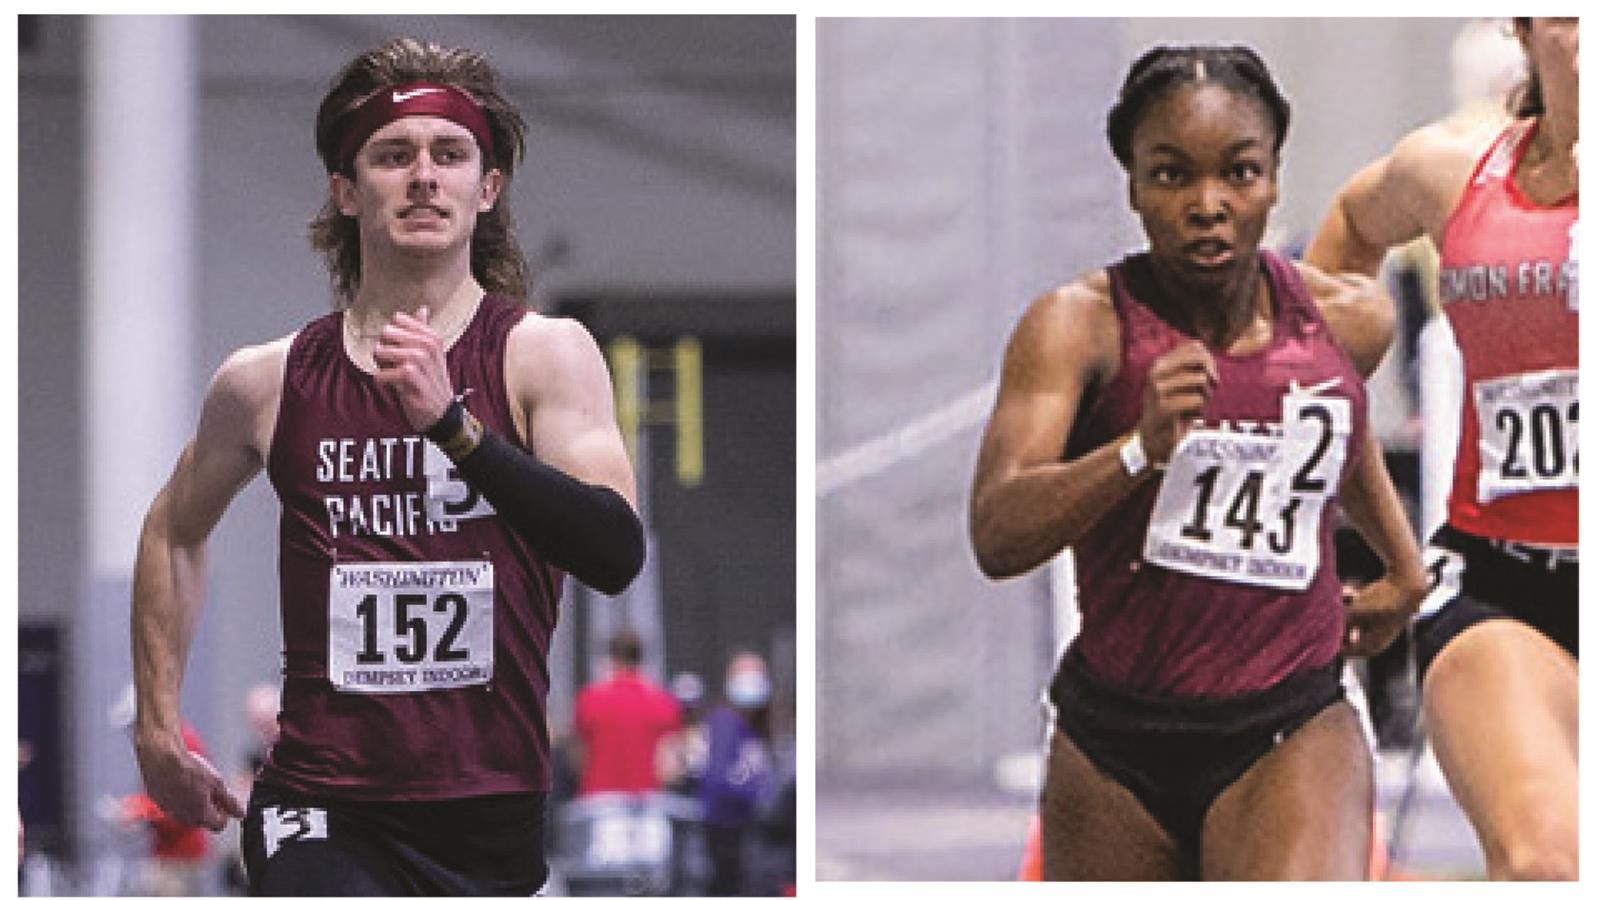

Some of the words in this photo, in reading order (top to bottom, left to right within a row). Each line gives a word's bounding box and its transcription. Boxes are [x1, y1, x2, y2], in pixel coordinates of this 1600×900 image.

[316, 437, 428, 482] SEATT
[1290, 405, 1333, 491] 2
[356, 593, 469, 665] 152
